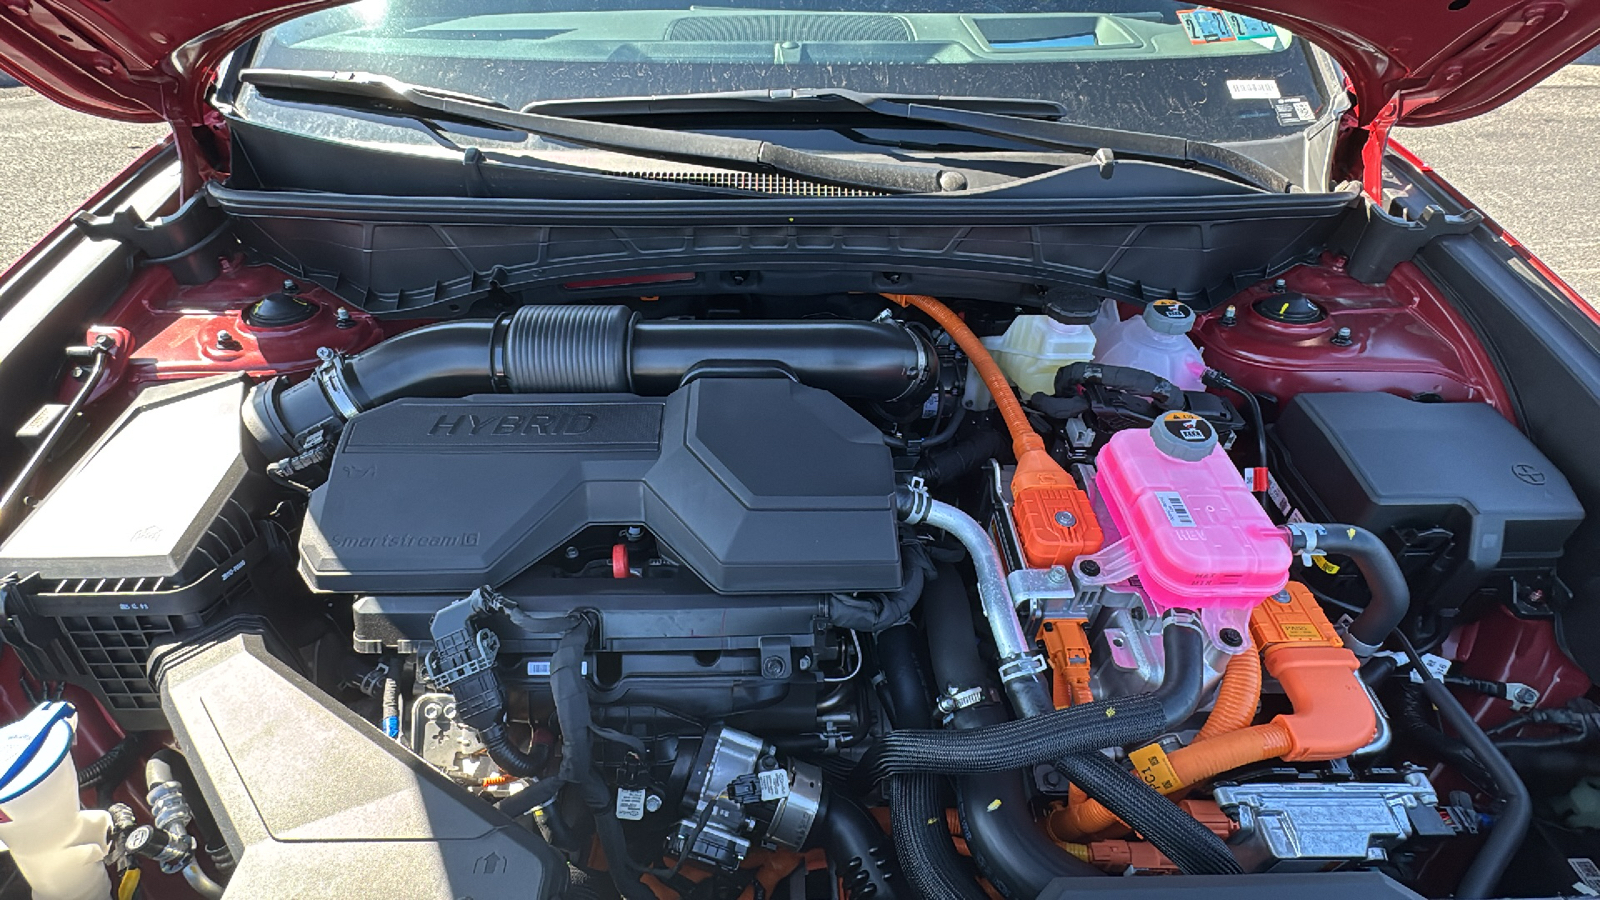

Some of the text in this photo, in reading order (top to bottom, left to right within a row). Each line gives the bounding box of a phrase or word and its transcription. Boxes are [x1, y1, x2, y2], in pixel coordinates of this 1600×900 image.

[427, 414, 597, 435] HYBRID
[331, 532, 459, 548] Smartstream
[1175, 530, 1207, 540] HEV
